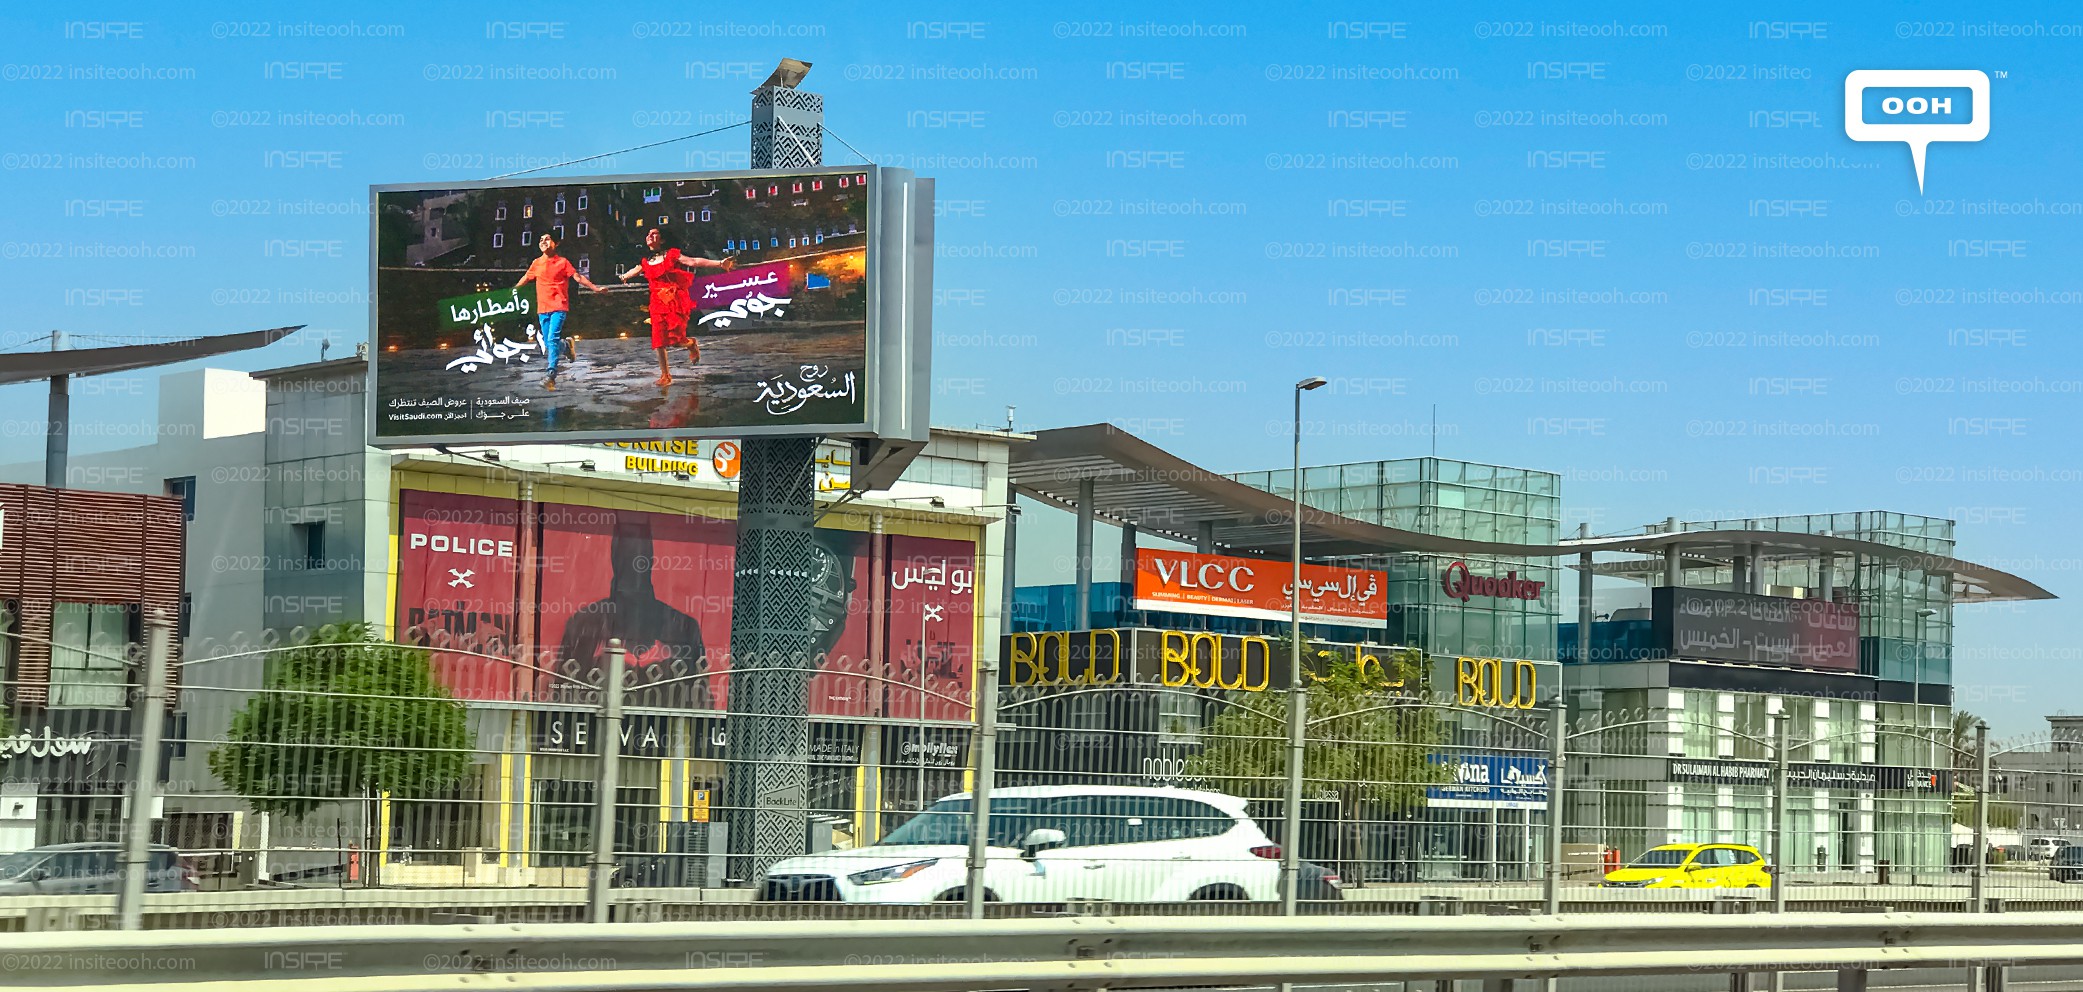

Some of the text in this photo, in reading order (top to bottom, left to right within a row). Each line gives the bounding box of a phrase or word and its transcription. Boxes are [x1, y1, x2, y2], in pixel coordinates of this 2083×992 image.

[702, 270, 779, 299] عسير
[450, 288, 530, 325] وأمطارها
[388, 412, 443, 421] VisitSaudi.com
[603, 439, 699, 456] NRISE
[625, 455, 699, 477] BUILDING
[410, 533, 514, 558] POLICE
[1154, 558, 1256, 592] VLCC
[1152, 591, 1181, 599] SLIMMING
[1187, 593, 1208, 601] BEAUTY
[1679, 627, 1740, 653] الخميس
[1010, 628, 1121, 687] BOLD
[1161, 629, 1270, 693] BOLD
[1457, 655, 1538, 710] BOLD
[809, 744, 832, 753] MADE
[841, 744, 860, 753] ITALY
[1682, 764, 1712, 777] SULAIMAN
[1712, 765, 1721, 777] AL
[1720, 765, 1739, 778] HABIB
[1739, 766, 1770, 779] PHARMACY
[1464, 785, 1490, 794] KITCHENS
